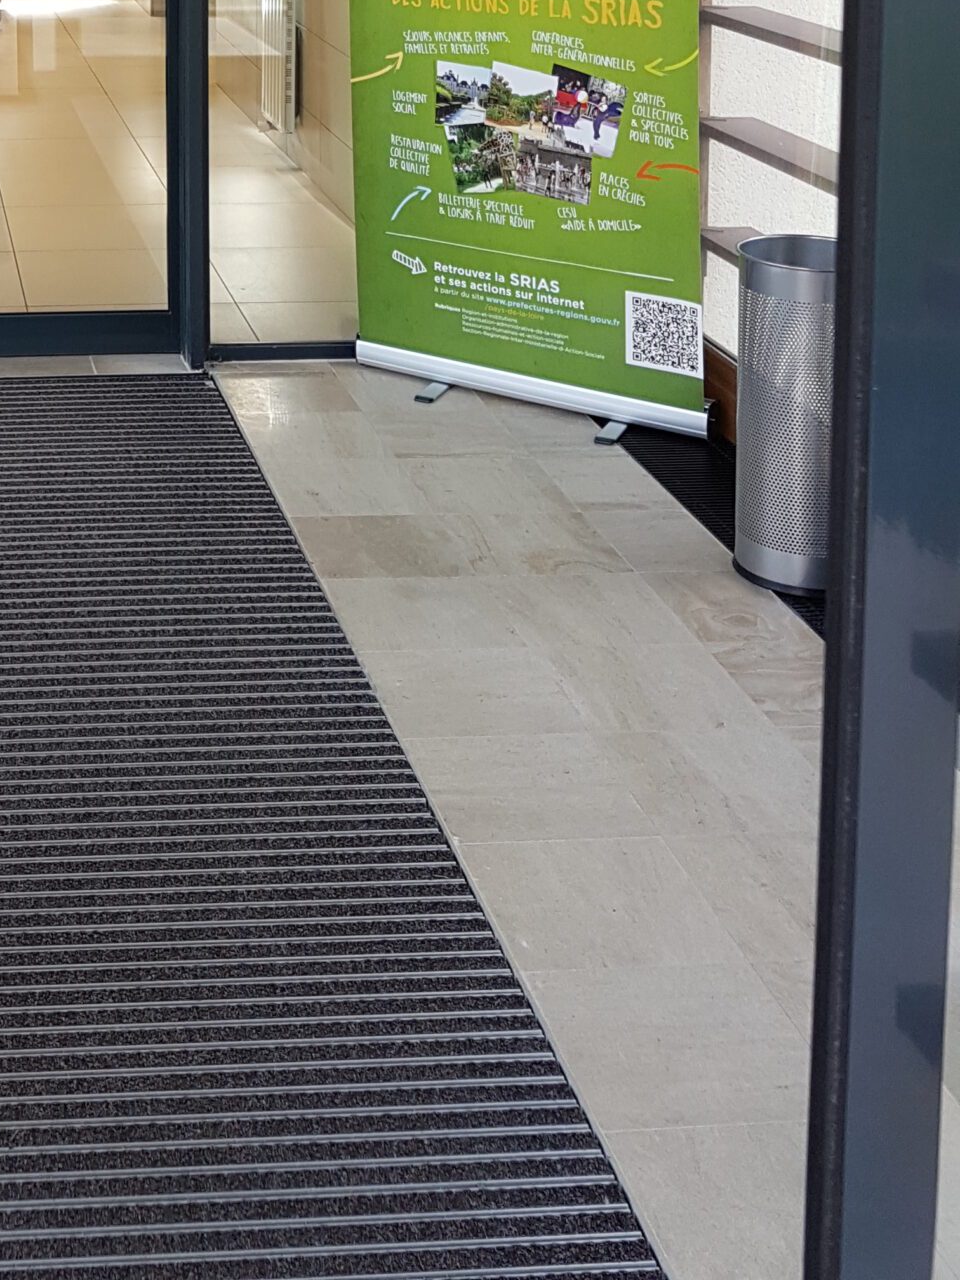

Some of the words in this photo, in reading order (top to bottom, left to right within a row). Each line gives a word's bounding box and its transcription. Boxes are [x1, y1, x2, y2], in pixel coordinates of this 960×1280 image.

[549, 0, 571, 19] LA
[403, 30, 432, 43] SÉJOURS
[435, 31, 472, 43] VACANCES
[475, 31, 511, 44] ENFANTS,
[532, 31, 584, 50] CONFÉRENCES
[404, 43, 437, 55] FAMILLES
[440, 43, 448, 55] ET
[451, 42, 490, 56] RETRAITÉS
[531, 43, 636, 72] INTER-GÉNÉRATIONNELLES
[392, 90, 427, 104] LOGEMENT
[633, 92, 666, 108] SORTIES
[392, 102, 416, 115] SOCIAL
[632, 105, 684, 126] COLLECTIVES
[631, 119, 638, 128] &
[641, 120, 689, 140] SPECTACLES
[391, 134, 442, 155] RESTAURATION
[630, 130, 650, 144] POUR
[654, 135, 674, 150] TOUS
[390, 146, 430, 164] COLLECTIVE
[390, 158, 398, 169] DE
[401, 161, 430, 177] QUALITÉ
[600, 172, 630, 190] PLACES
[438, 192, 481, 210] BILLETTERIE
[483, 199, 524, 216] SPECTACLE
[599, 185, 609, 196] EN
[612, 188, 646, 207] CRÈCHES
[439, 207, 445, 215] &
[448, 207, 474, 221] LOISIRS
[476, 210, 482, 221] À
[485, 213, 506, 226] TARIF
[509, 215, 535, 230] RÉDUIT
[557, 207, 577, 219] CESU
[561, 220, 586, 232] «AIDE
[589, 218, 595, 231] À
[598, 220, 642, 232] DOMICILE»
[434, 261, 491, 281] Retrouvez
[495, 272, 505, 283] la
[510, 273, 560, 294] SRIAS
[434, 275, 446, 285] et
[449, 278, 467, 289] ses
[470, 281, 512, 297] actions
[515, 291, 533, 301] sur
[440, 287, 458, 298] partir
[461, 291, 470, 299] du
[472, 293, 484, 302] site
